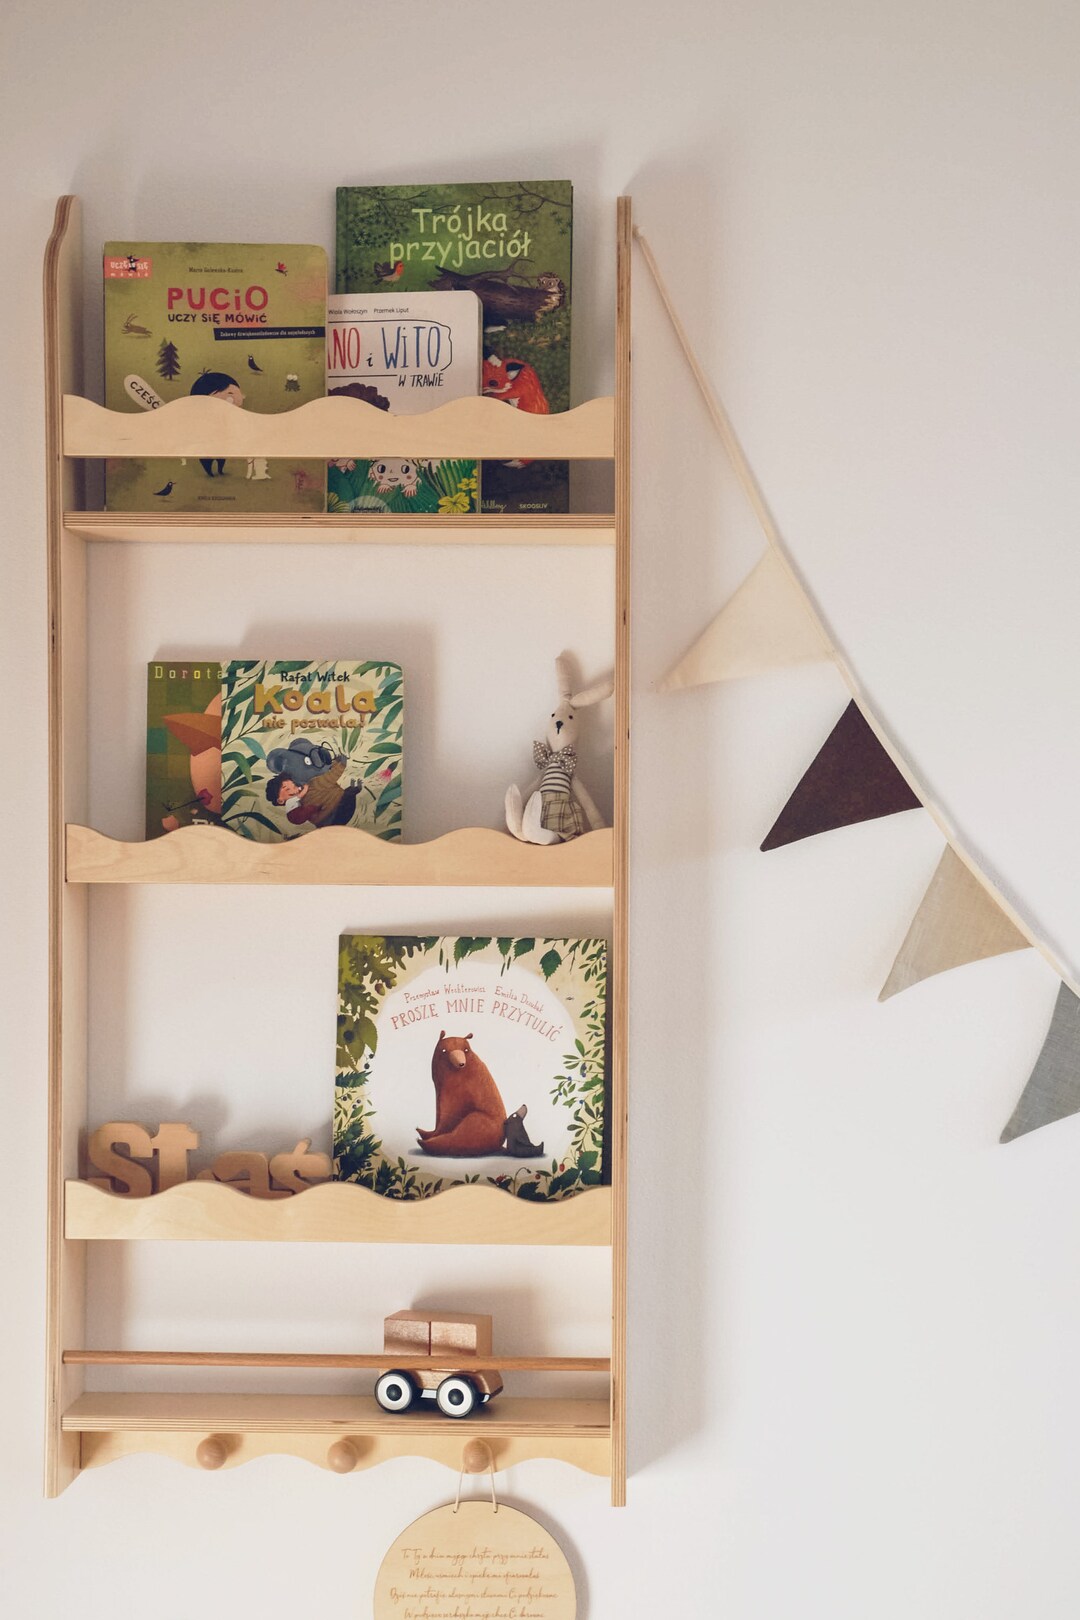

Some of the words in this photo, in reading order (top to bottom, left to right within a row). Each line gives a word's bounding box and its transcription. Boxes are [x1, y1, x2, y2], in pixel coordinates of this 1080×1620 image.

[412, 205, 508, 241] Trójka
[390, 229, 531, 269] przyjaciół
[168, 313, 197, 323] UCZY
[396, 307, 409, 315] Liput
[366, 353, 373, 367] i
[398, 375, 406, 387] W
[130, 381, 161, 410] CZEŚĆ
[154, 665, 222, 680] Dorota
[281, 670, 312, 684] Rafał
[317, 670, 350, 682] Witek
[253, 684, 377, 716] Koala
[262, 715, 286, 729] nie
[291, 714, 366, 735] pozwala!
[404, 989, 440, 1004] Przemysław
[494, 986, 518, 1001] Emilia
[390, 1003, 439, 1030] PROSZĘ
[446, 999, 485, 1014] MNIE
[491, 1001, 564, 1042] PRZYTULIĆ
